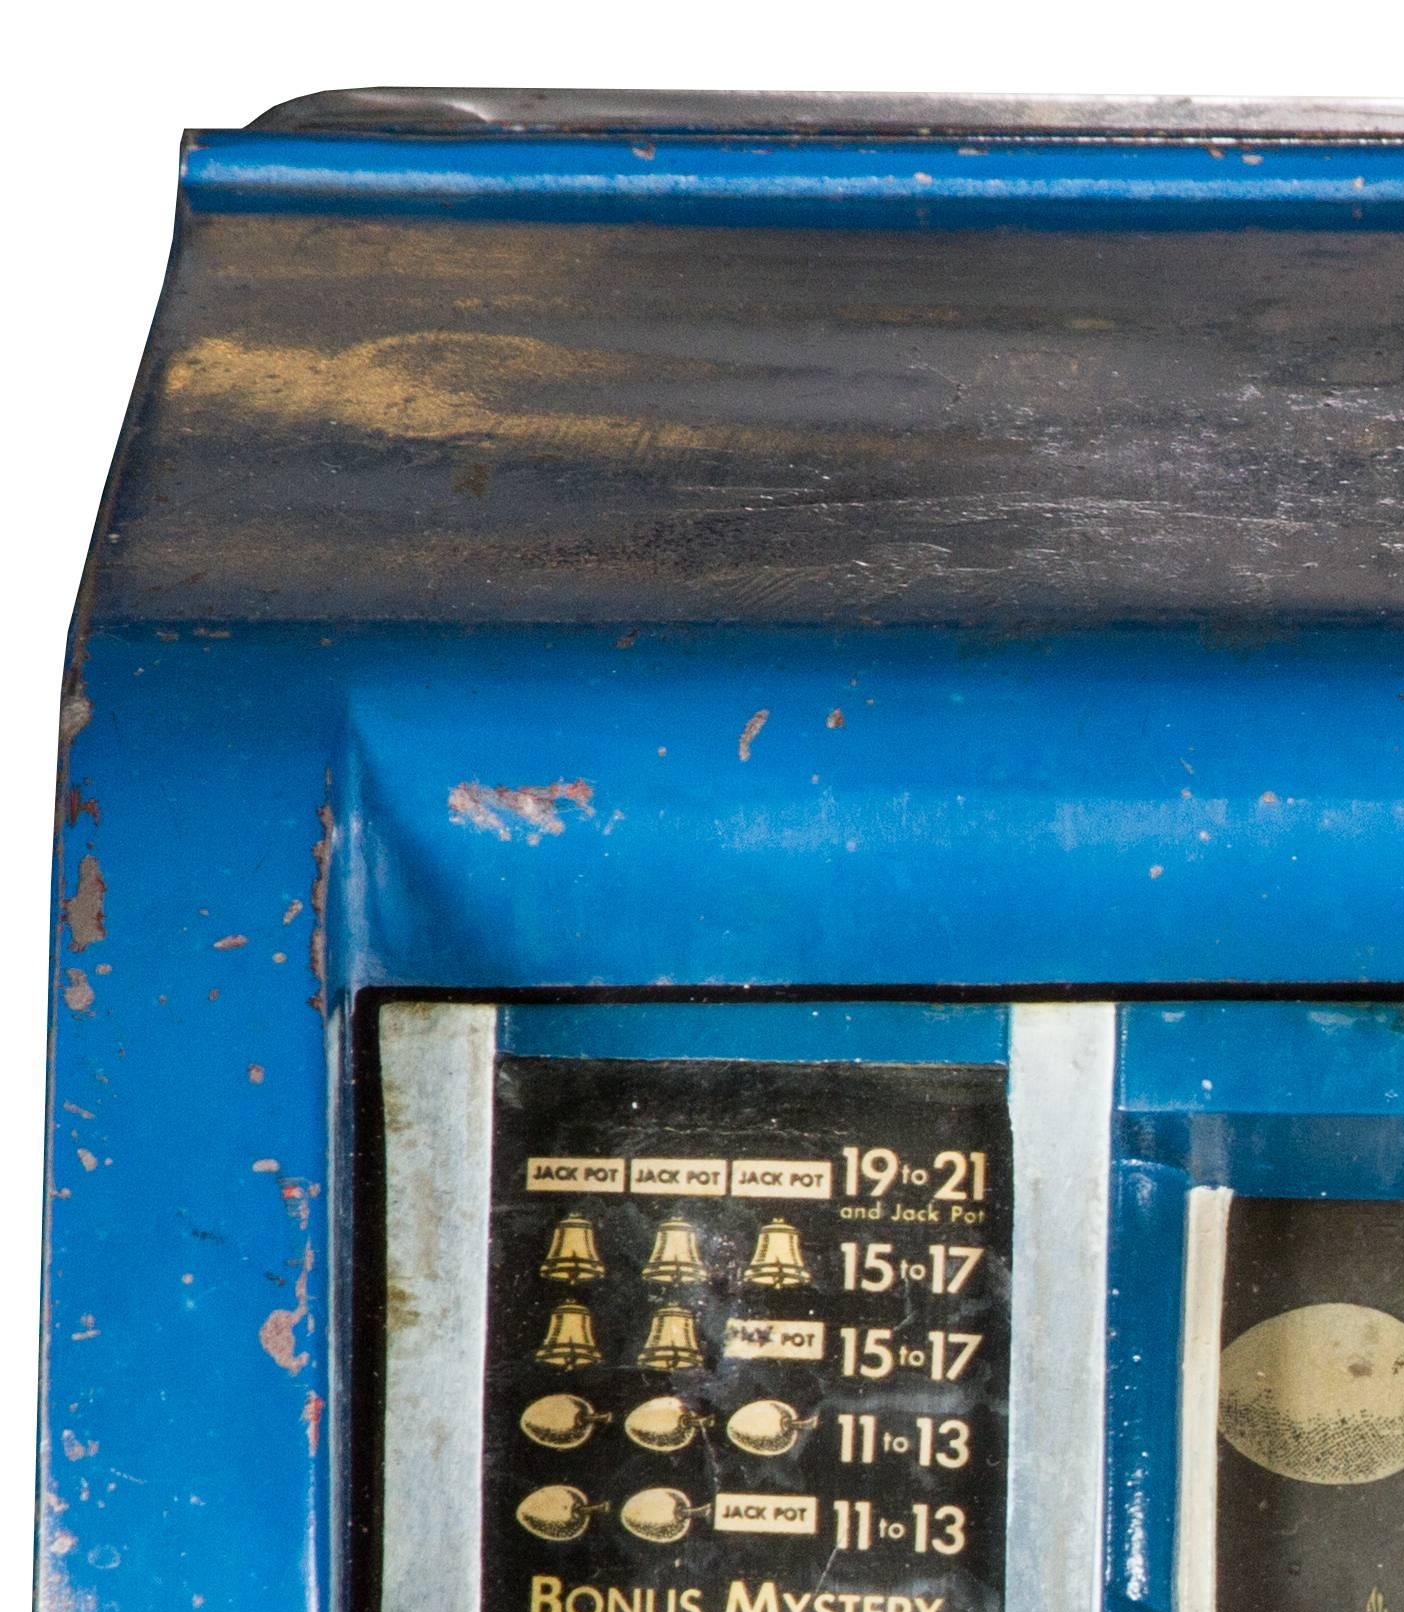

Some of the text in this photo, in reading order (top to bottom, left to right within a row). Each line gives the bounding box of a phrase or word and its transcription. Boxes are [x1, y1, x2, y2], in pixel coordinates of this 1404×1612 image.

[532, 1146, 985, 1201] JACK POT JACK POT JACK POT 19 to 21
[839, 1201, 985, 1225] and Jack Pot
[840, 1242, 983, 1294] 15 to 17
[780, 1332, 816, 1348] POT
[840, 1327, 894, 1379] 15
[898, 1345, 926, 1367] to
[928, 1330, 982, 1382] 17
[837, 1414, 969, 1469] 11 to 13
[722, 1500, 965, 1555] JACK POT 11 to 13
